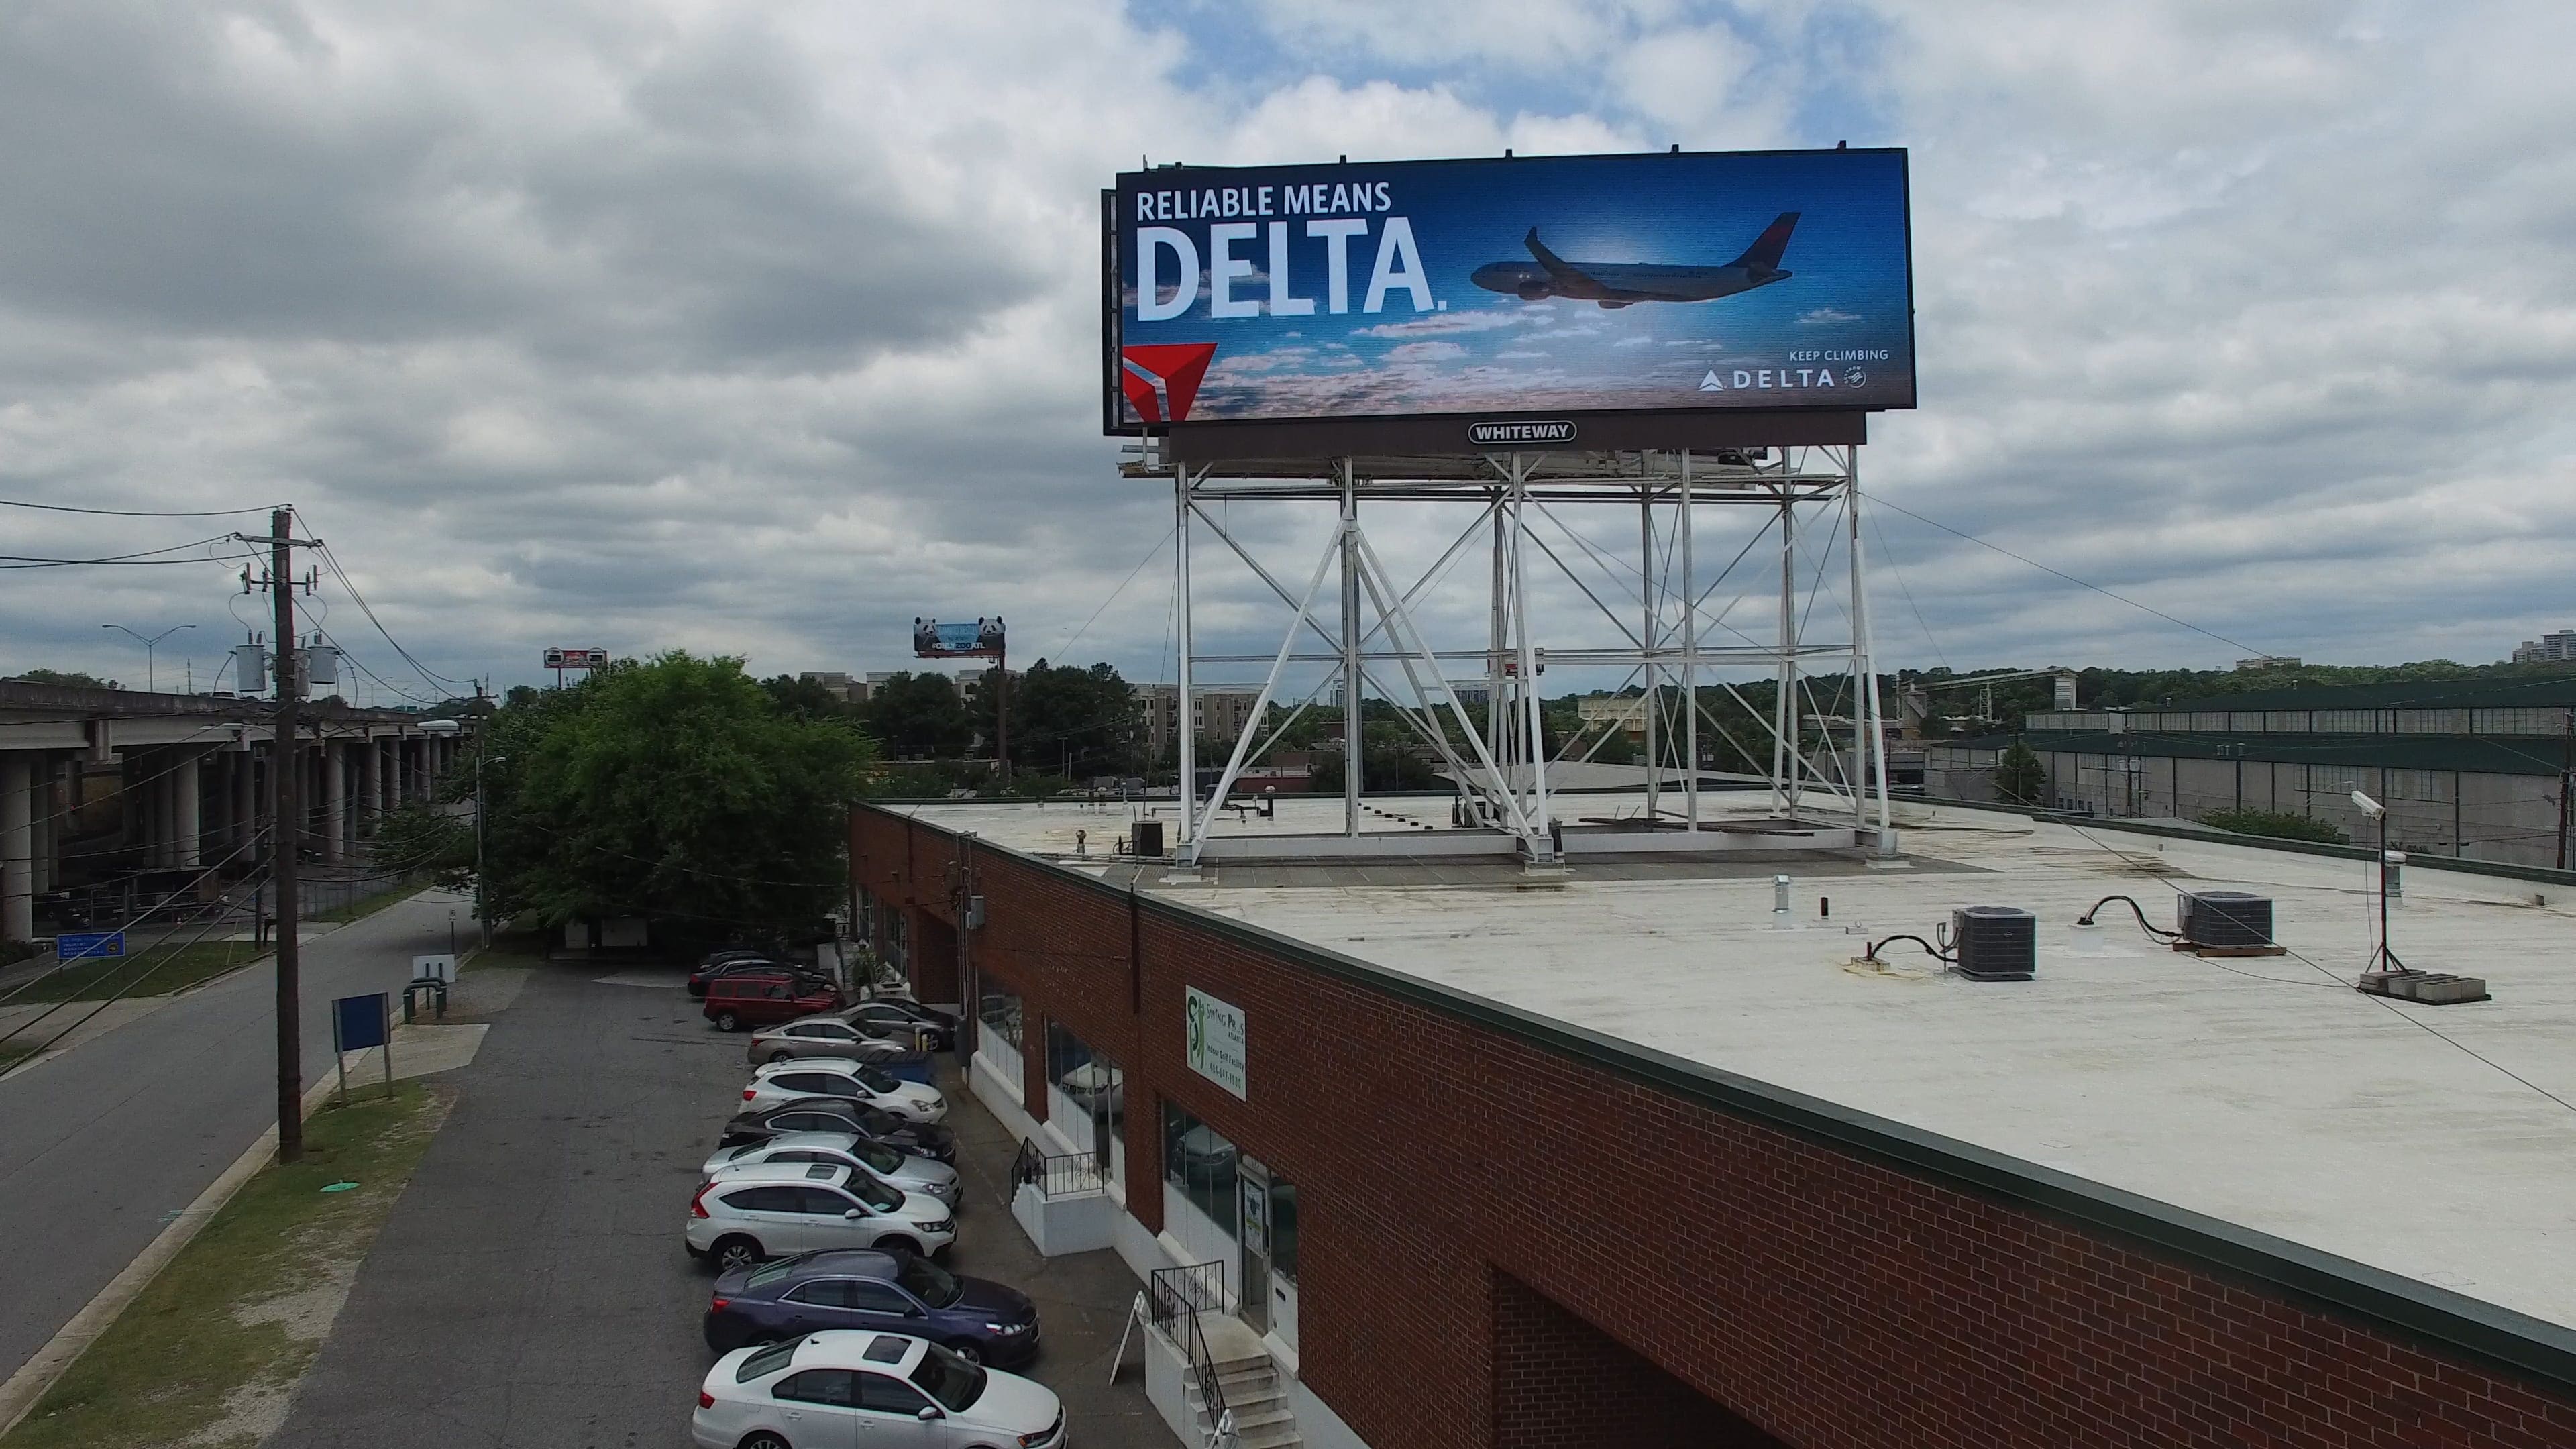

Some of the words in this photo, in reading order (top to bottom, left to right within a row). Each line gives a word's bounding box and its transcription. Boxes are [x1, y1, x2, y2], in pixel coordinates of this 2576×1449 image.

[1136, 186, 1274, 221] RELIABLE
[1283, 182, 1391, 215] MEANS
[1136, 216, 1447, 322] DELTA.
[1789, 350, 1821, 362] KEEP
[1824, 349, 1889, 361] CLIMBING
[1733, 368, 1835, 388] DELTA
[1476, 424, 1569, 440] WHITEWAY
[1206, 1003, 1226, 1027] SWING
[1228, 1014, 1244, 1036] PRS
